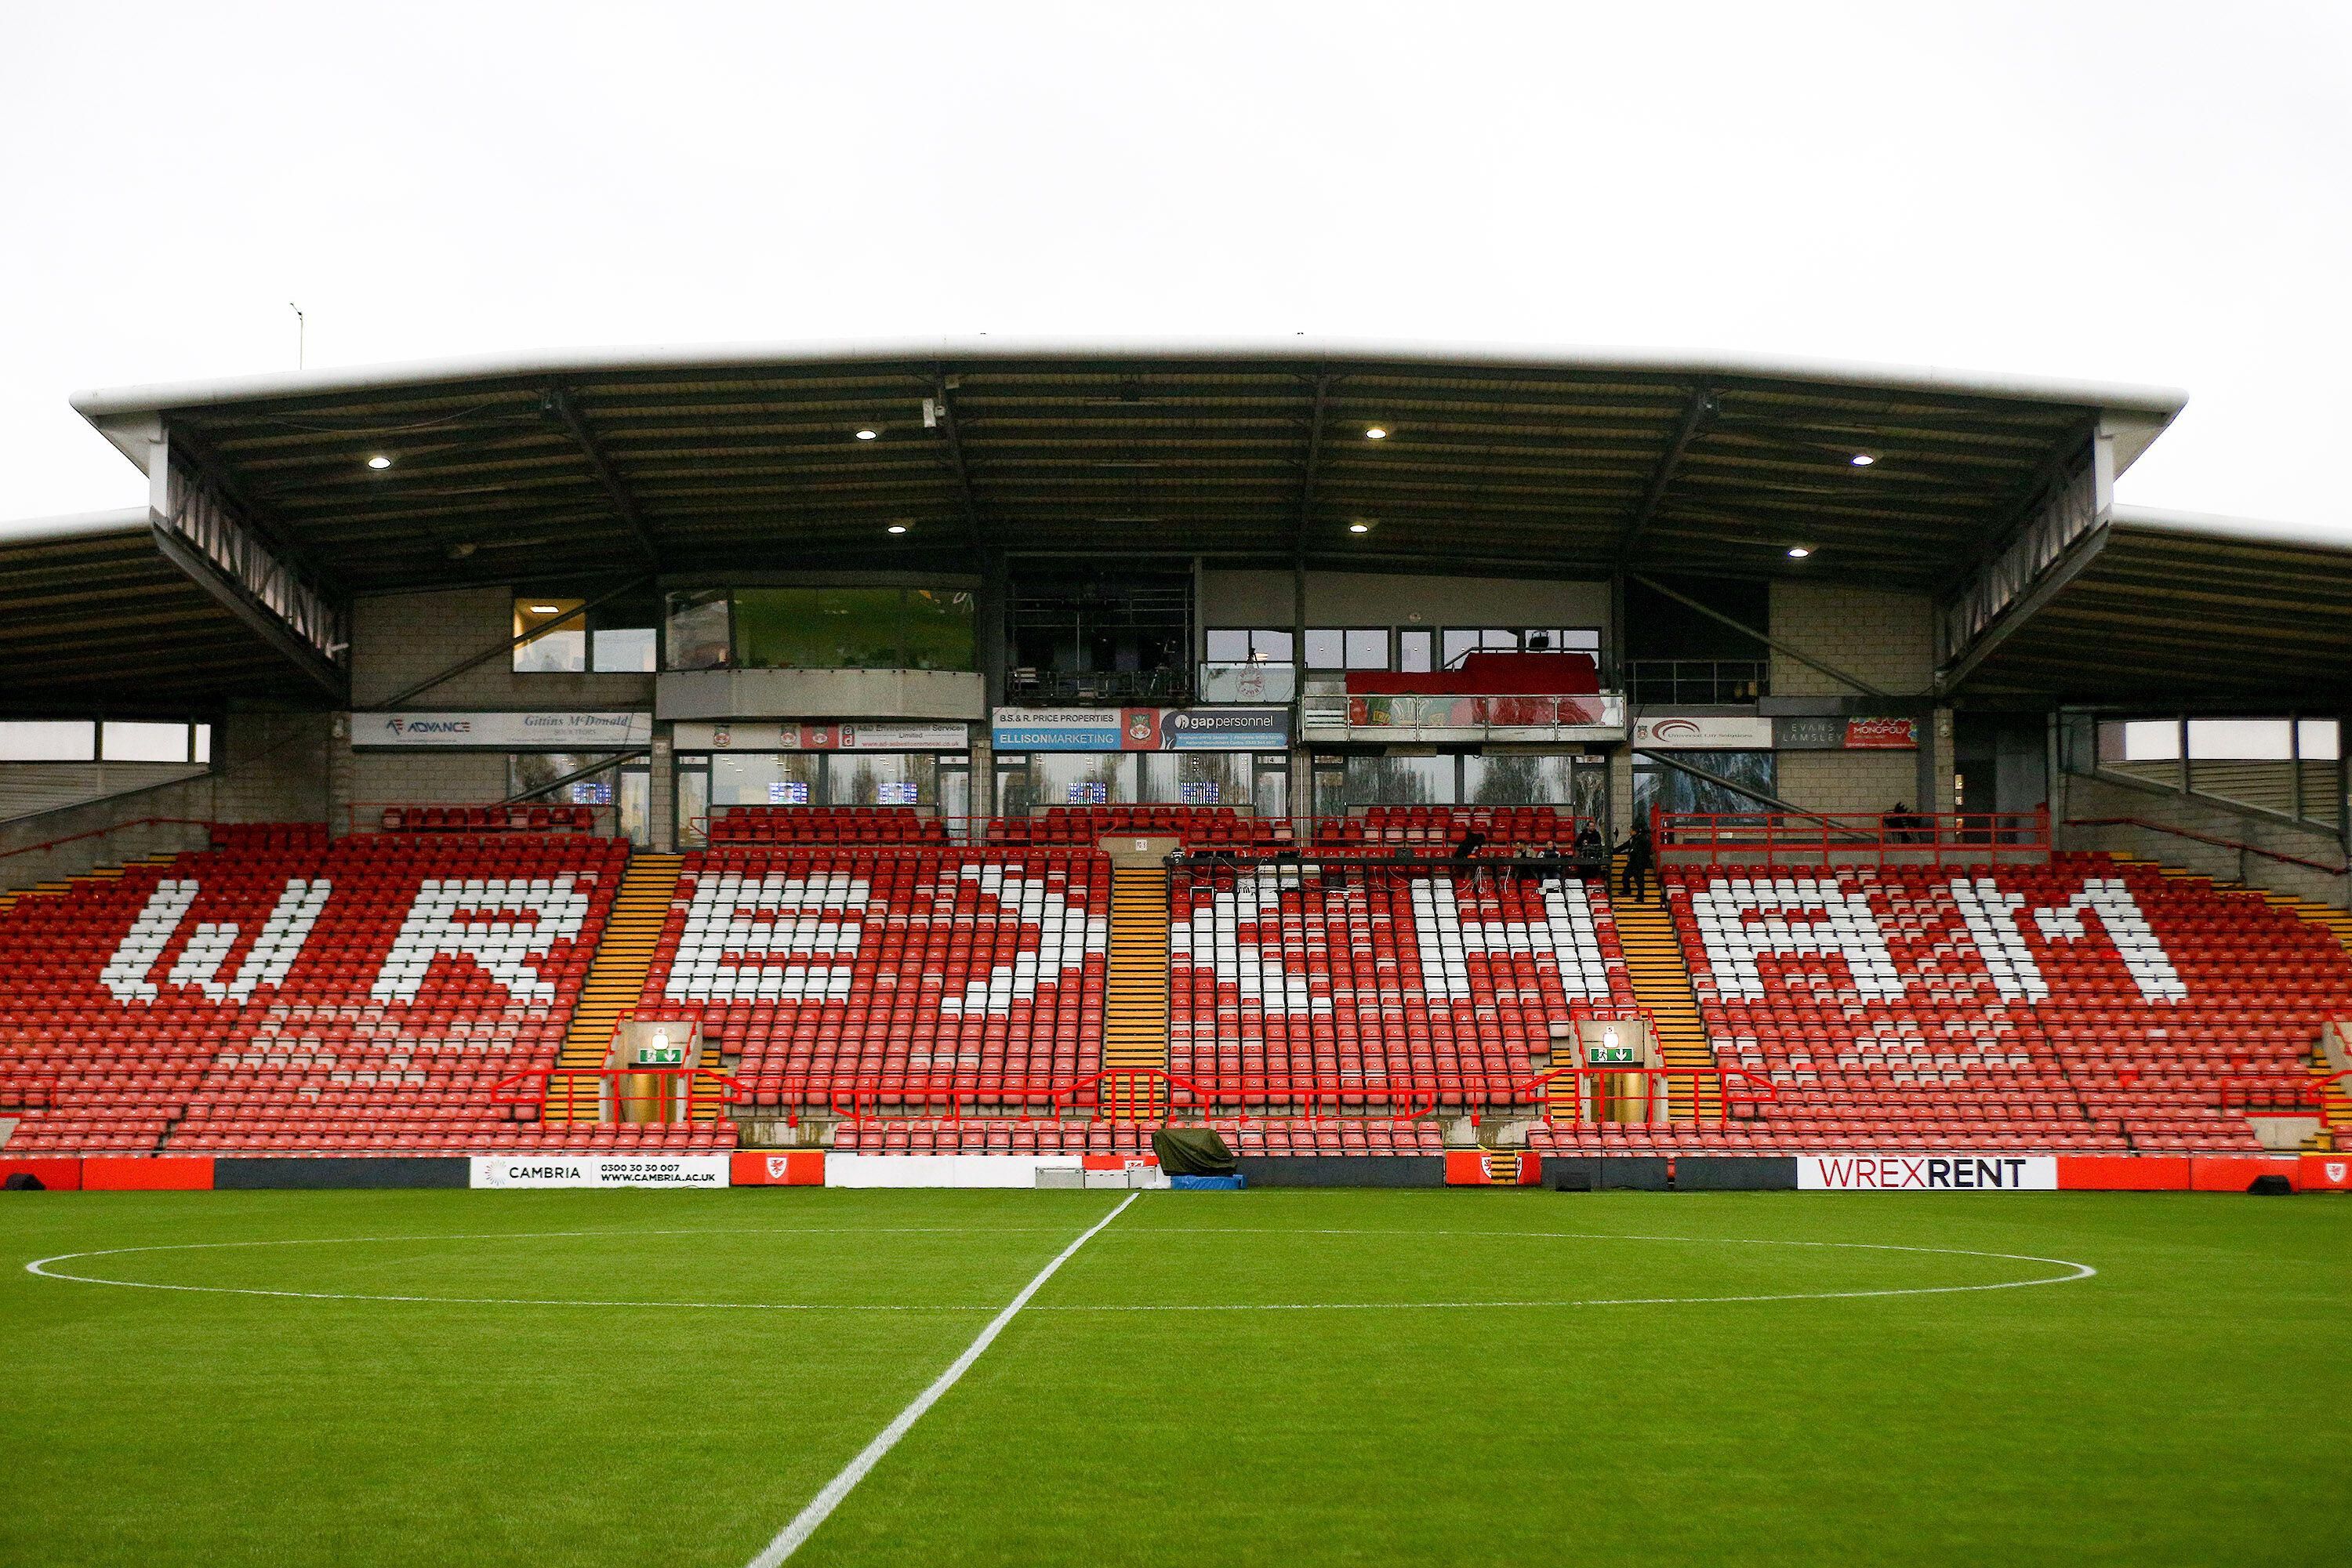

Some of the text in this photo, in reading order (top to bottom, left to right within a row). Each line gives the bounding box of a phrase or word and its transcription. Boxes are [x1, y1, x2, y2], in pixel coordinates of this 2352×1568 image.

[408, 721, 470, 732] ADVANCE
[524, 715, 629, 727] Gittins McDonald
[1791, 723, 1834, 731] EVANS
[509, 1167, 581, 1179] CAMBRIA
[1818, 1159, 2027, 1187] WREXRENT
